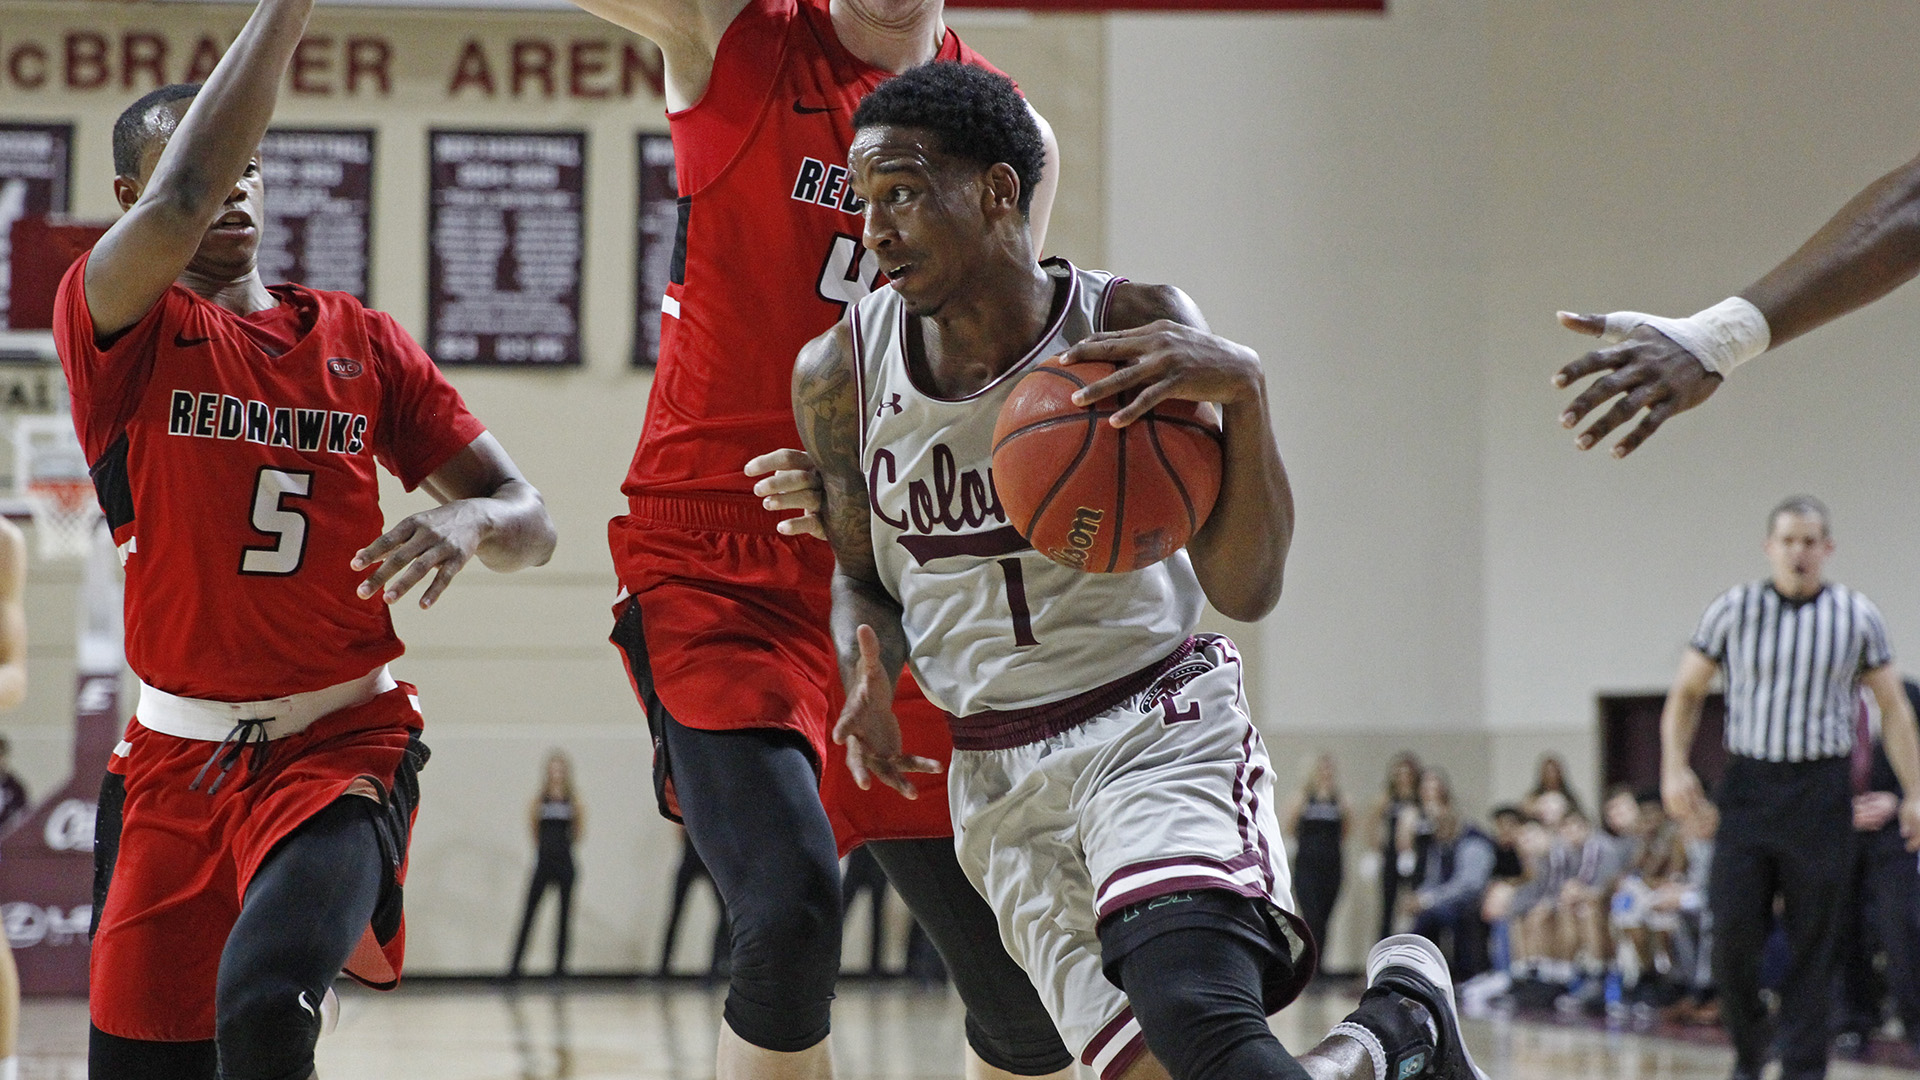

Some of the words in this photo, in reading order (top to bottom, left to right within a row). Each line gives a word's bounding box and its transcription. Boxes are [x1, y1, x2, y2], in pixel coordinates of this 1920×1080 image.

[7, 31, 393, 93] cBRAER
[449, 40, 665, 97] AREN
[168, 389, 368, 455] REDHAWKS
[237, 464, 316, 577] 5
[869, 443, 1007, 535] Colo
[1047, 505, 1105, 573] lson
[997, 557, 1041, 647] 1
